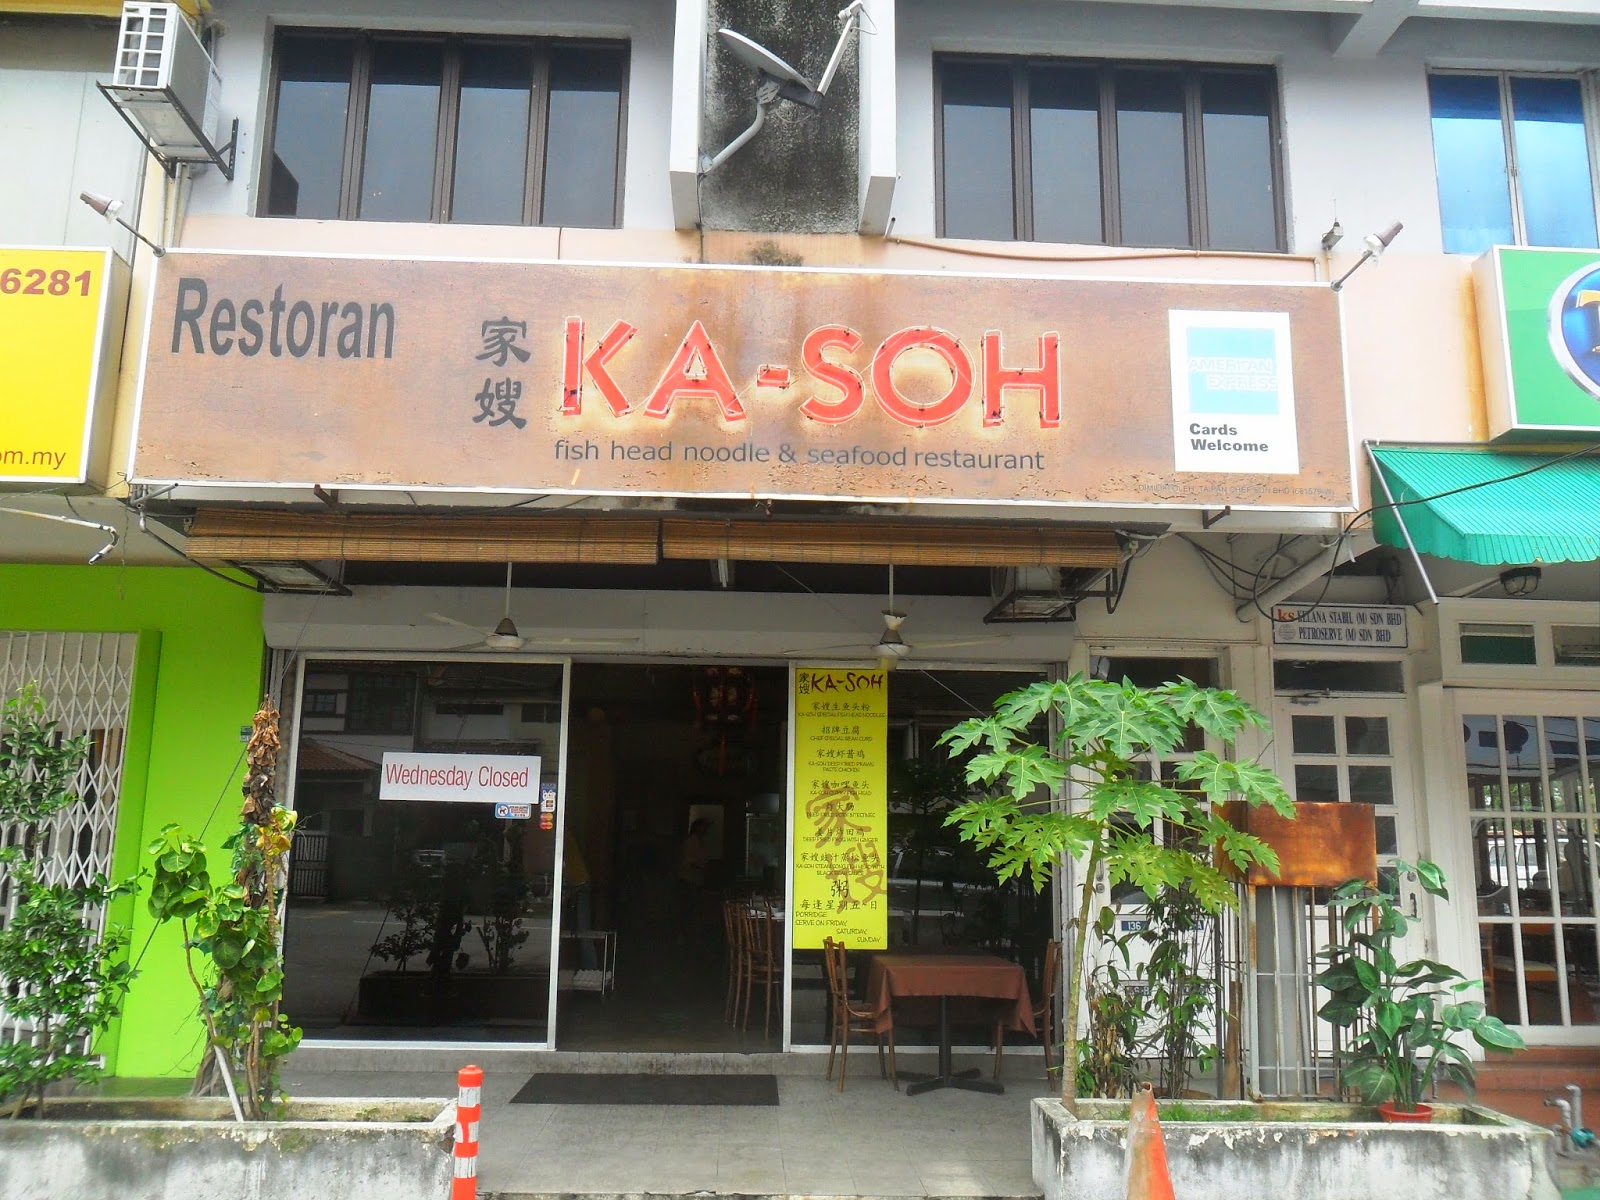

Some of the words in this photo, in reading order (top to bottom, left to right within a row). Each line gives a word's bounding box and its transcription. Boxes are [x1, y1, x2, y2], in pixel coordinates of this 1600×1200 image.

[0, 268, 91, 296] 6281
[171, 277, 395, 359] Restoran
[472, 316, 531, 429] 家嫂
[561, 316, 1062, 430] KA-SOH
[1187, 359, 1271, 372] AMERICAN
[1207, 375, 1279, 390] EXPRESS
[1189, 422, 1238, 436] Cards
[1190, 438, 1269, 452] Welcome
[554, 440, 598, 460] fish
[610, 440, 673, 462] head
[684, 442, 769, 463] noodle
[778, 444, 797, 463] &
[807, 445, 906, 467] seafood
[914, 449, 1045, 470] restaurant
[1370, 612, 1384, 625] SDN
[1386, 612, 1402, 626] BHD
[1299, 626, 1343, 641] PETROSERVE
[1359, 628, 1373, 641] SDN
[1376, 629, 1391, 642] BHD
[811, 672, 884, 693] KA-SOH
[385, 763, 473, 791] Wednesday
[478, 766, 529, 788] Closed
[831, 879, 849, 898] 粥
[1127, 921, 1142, 931] 136
